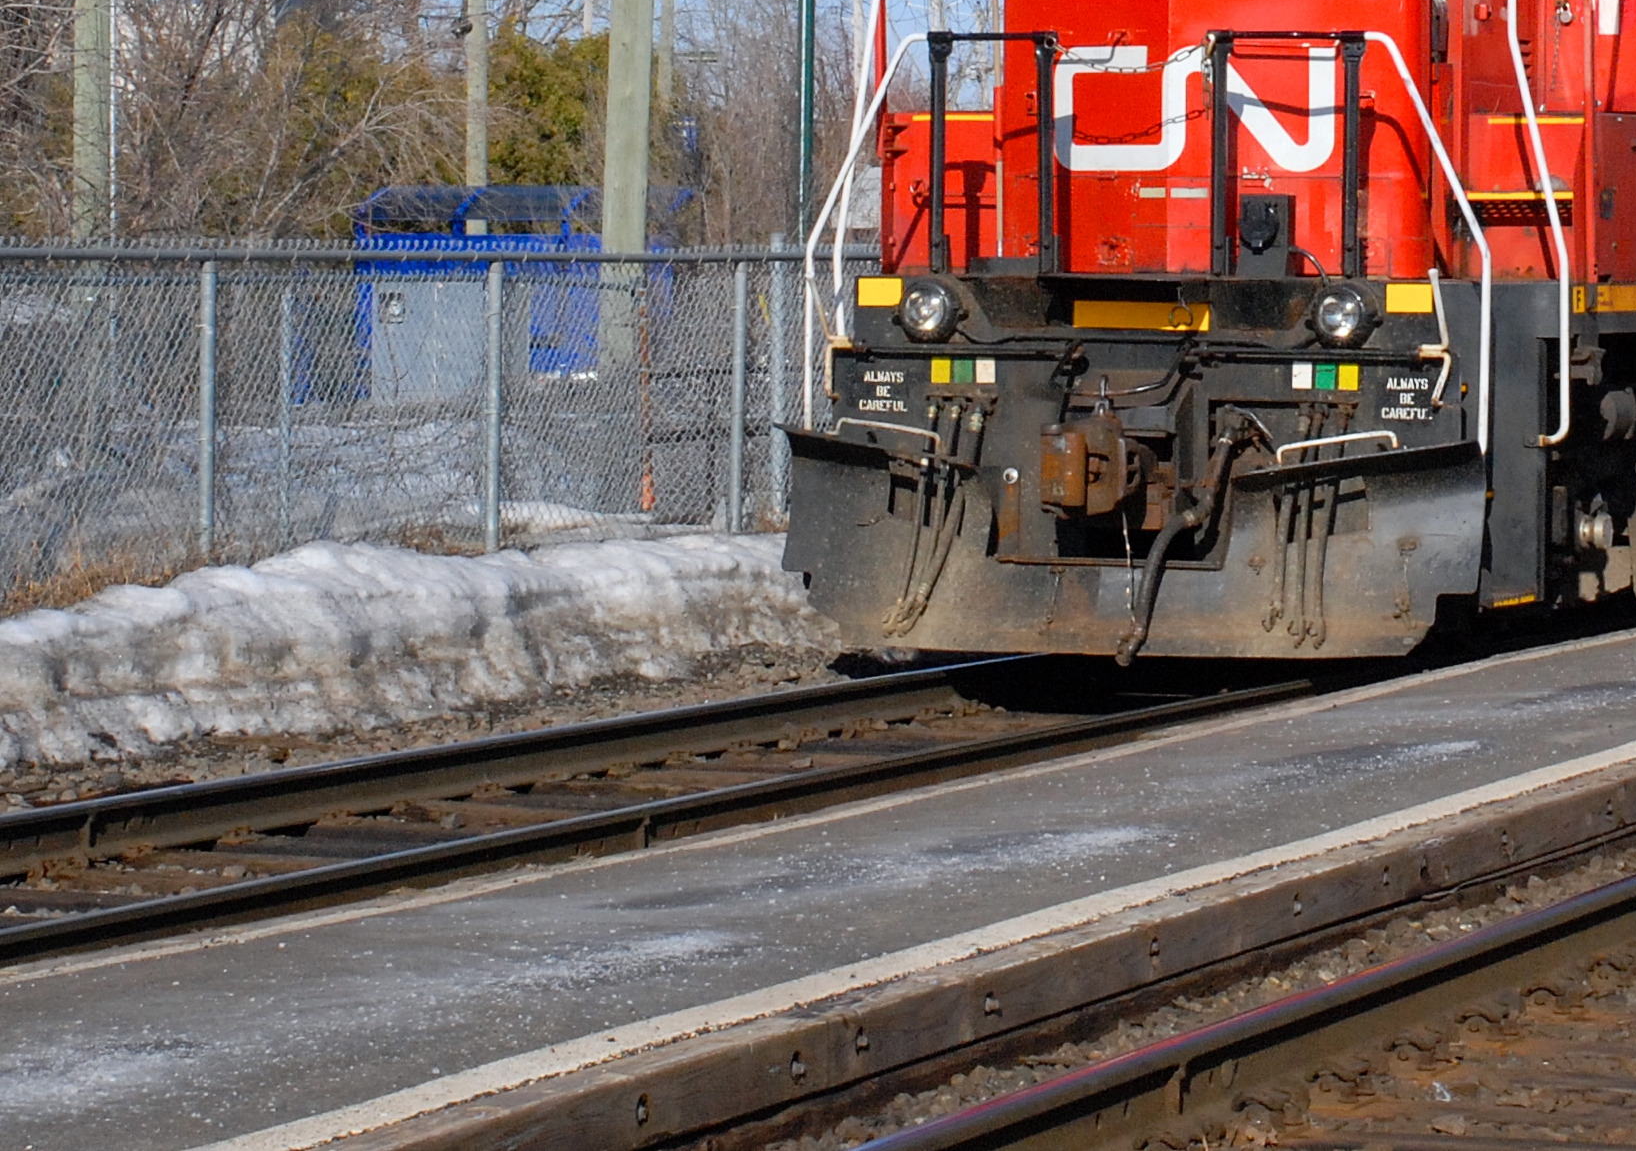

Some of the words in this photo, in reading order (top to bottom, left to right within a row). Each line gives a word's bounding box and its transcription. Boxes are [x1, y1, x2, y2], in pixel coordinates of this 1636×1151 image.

[1055, 45, 1336, 172] CN
[863, 371, 904, 383] ALWAYS
[1386, 377, 1429, 390] ALWAYS
[875, 385, 891, 397] BE
[1399, 392, 1415, 405] BE
[859, 399, 908, 412] CAREFUL
